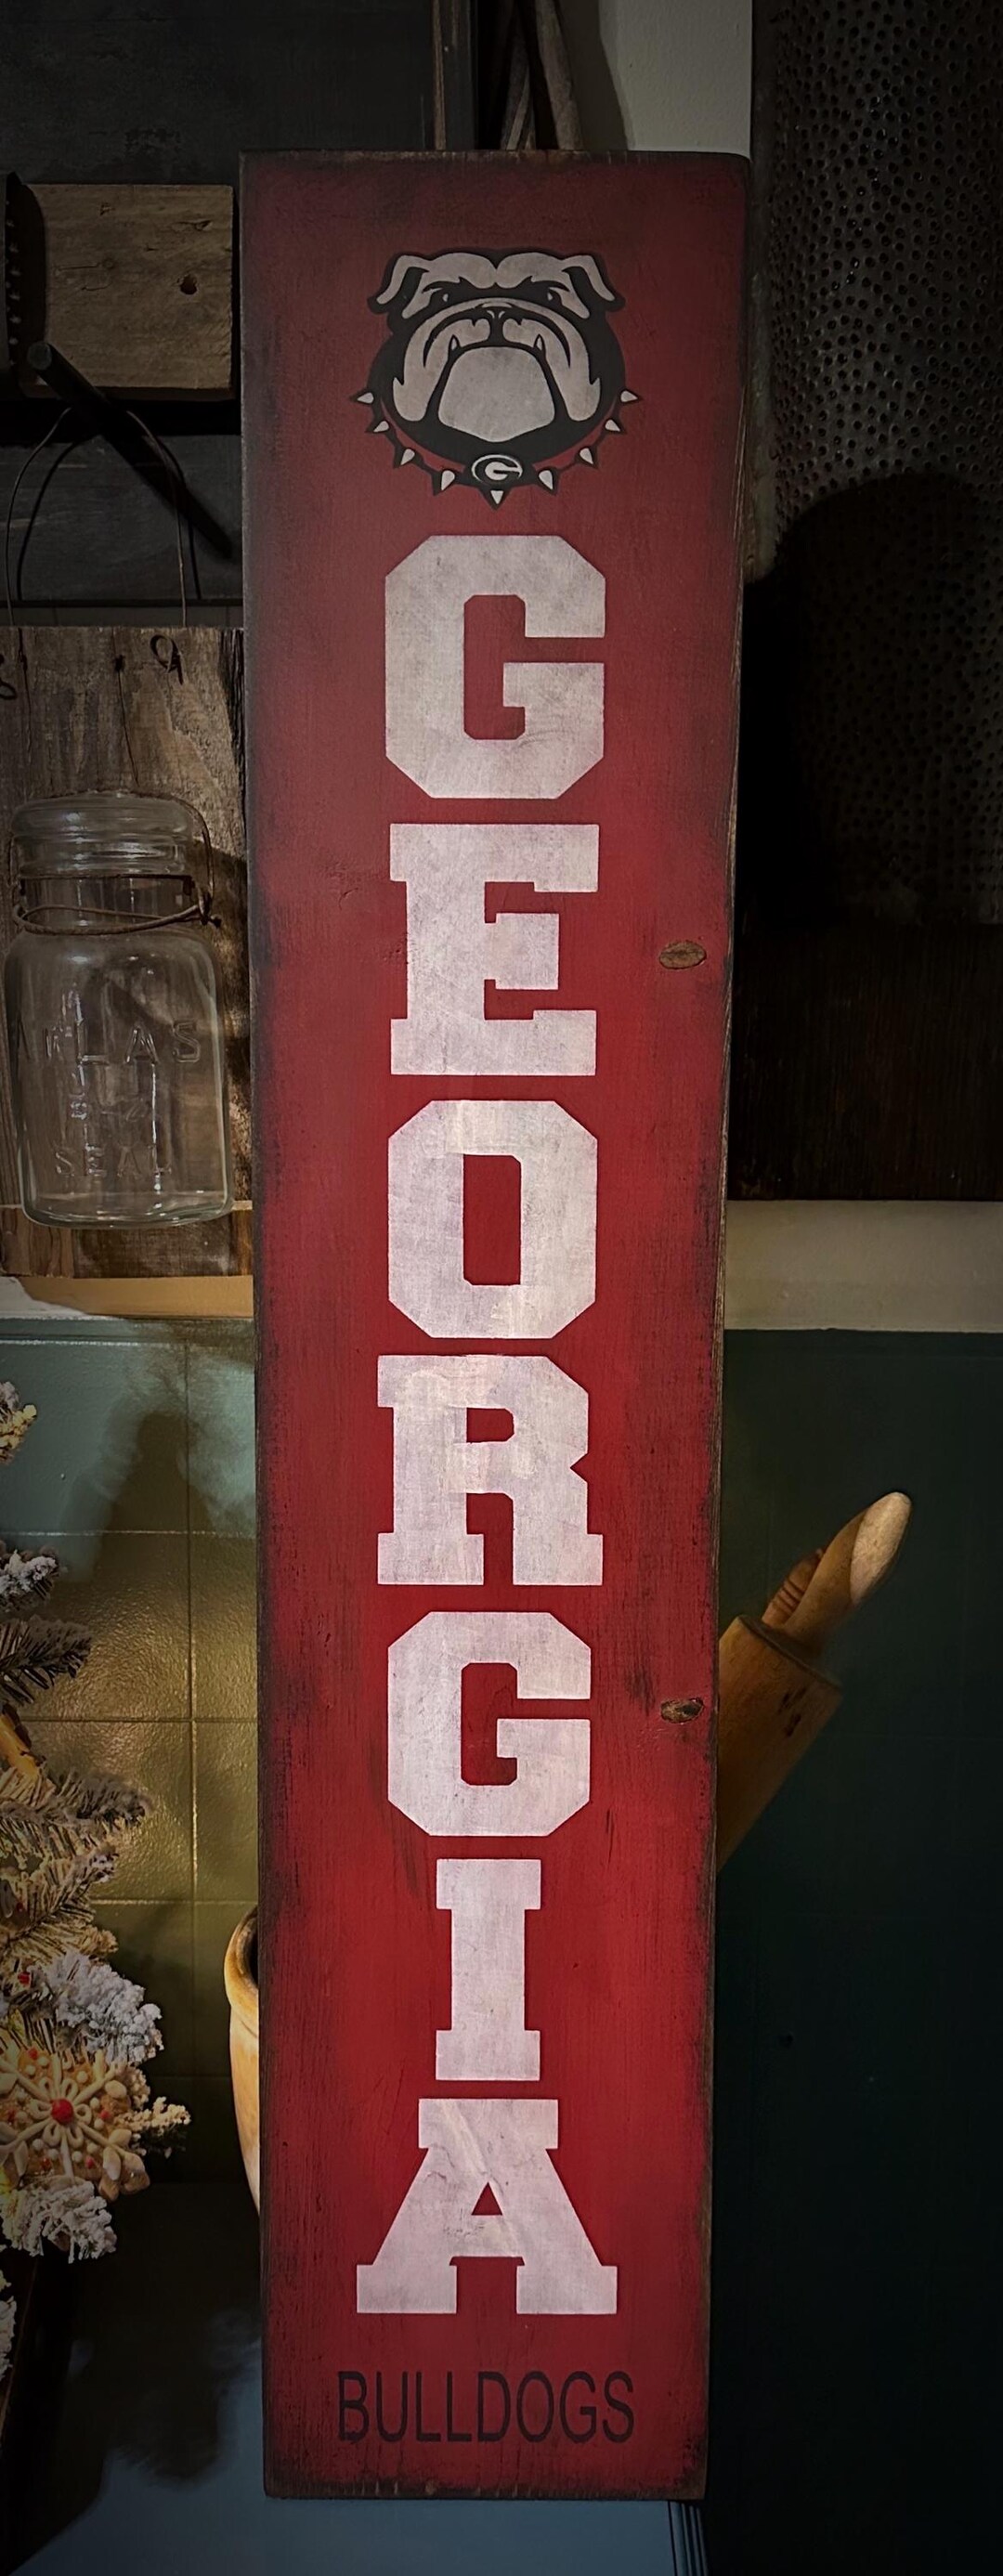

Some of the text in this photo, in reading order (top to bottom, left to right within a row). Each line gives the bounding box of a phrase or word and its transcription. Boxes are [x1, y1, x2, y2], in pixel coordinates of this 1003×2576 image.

[470, 453, 524, 485] G
[355, 535, 619, 2315] GEORGIA
[337, 2370, 635, 2443] BULLDOGS
